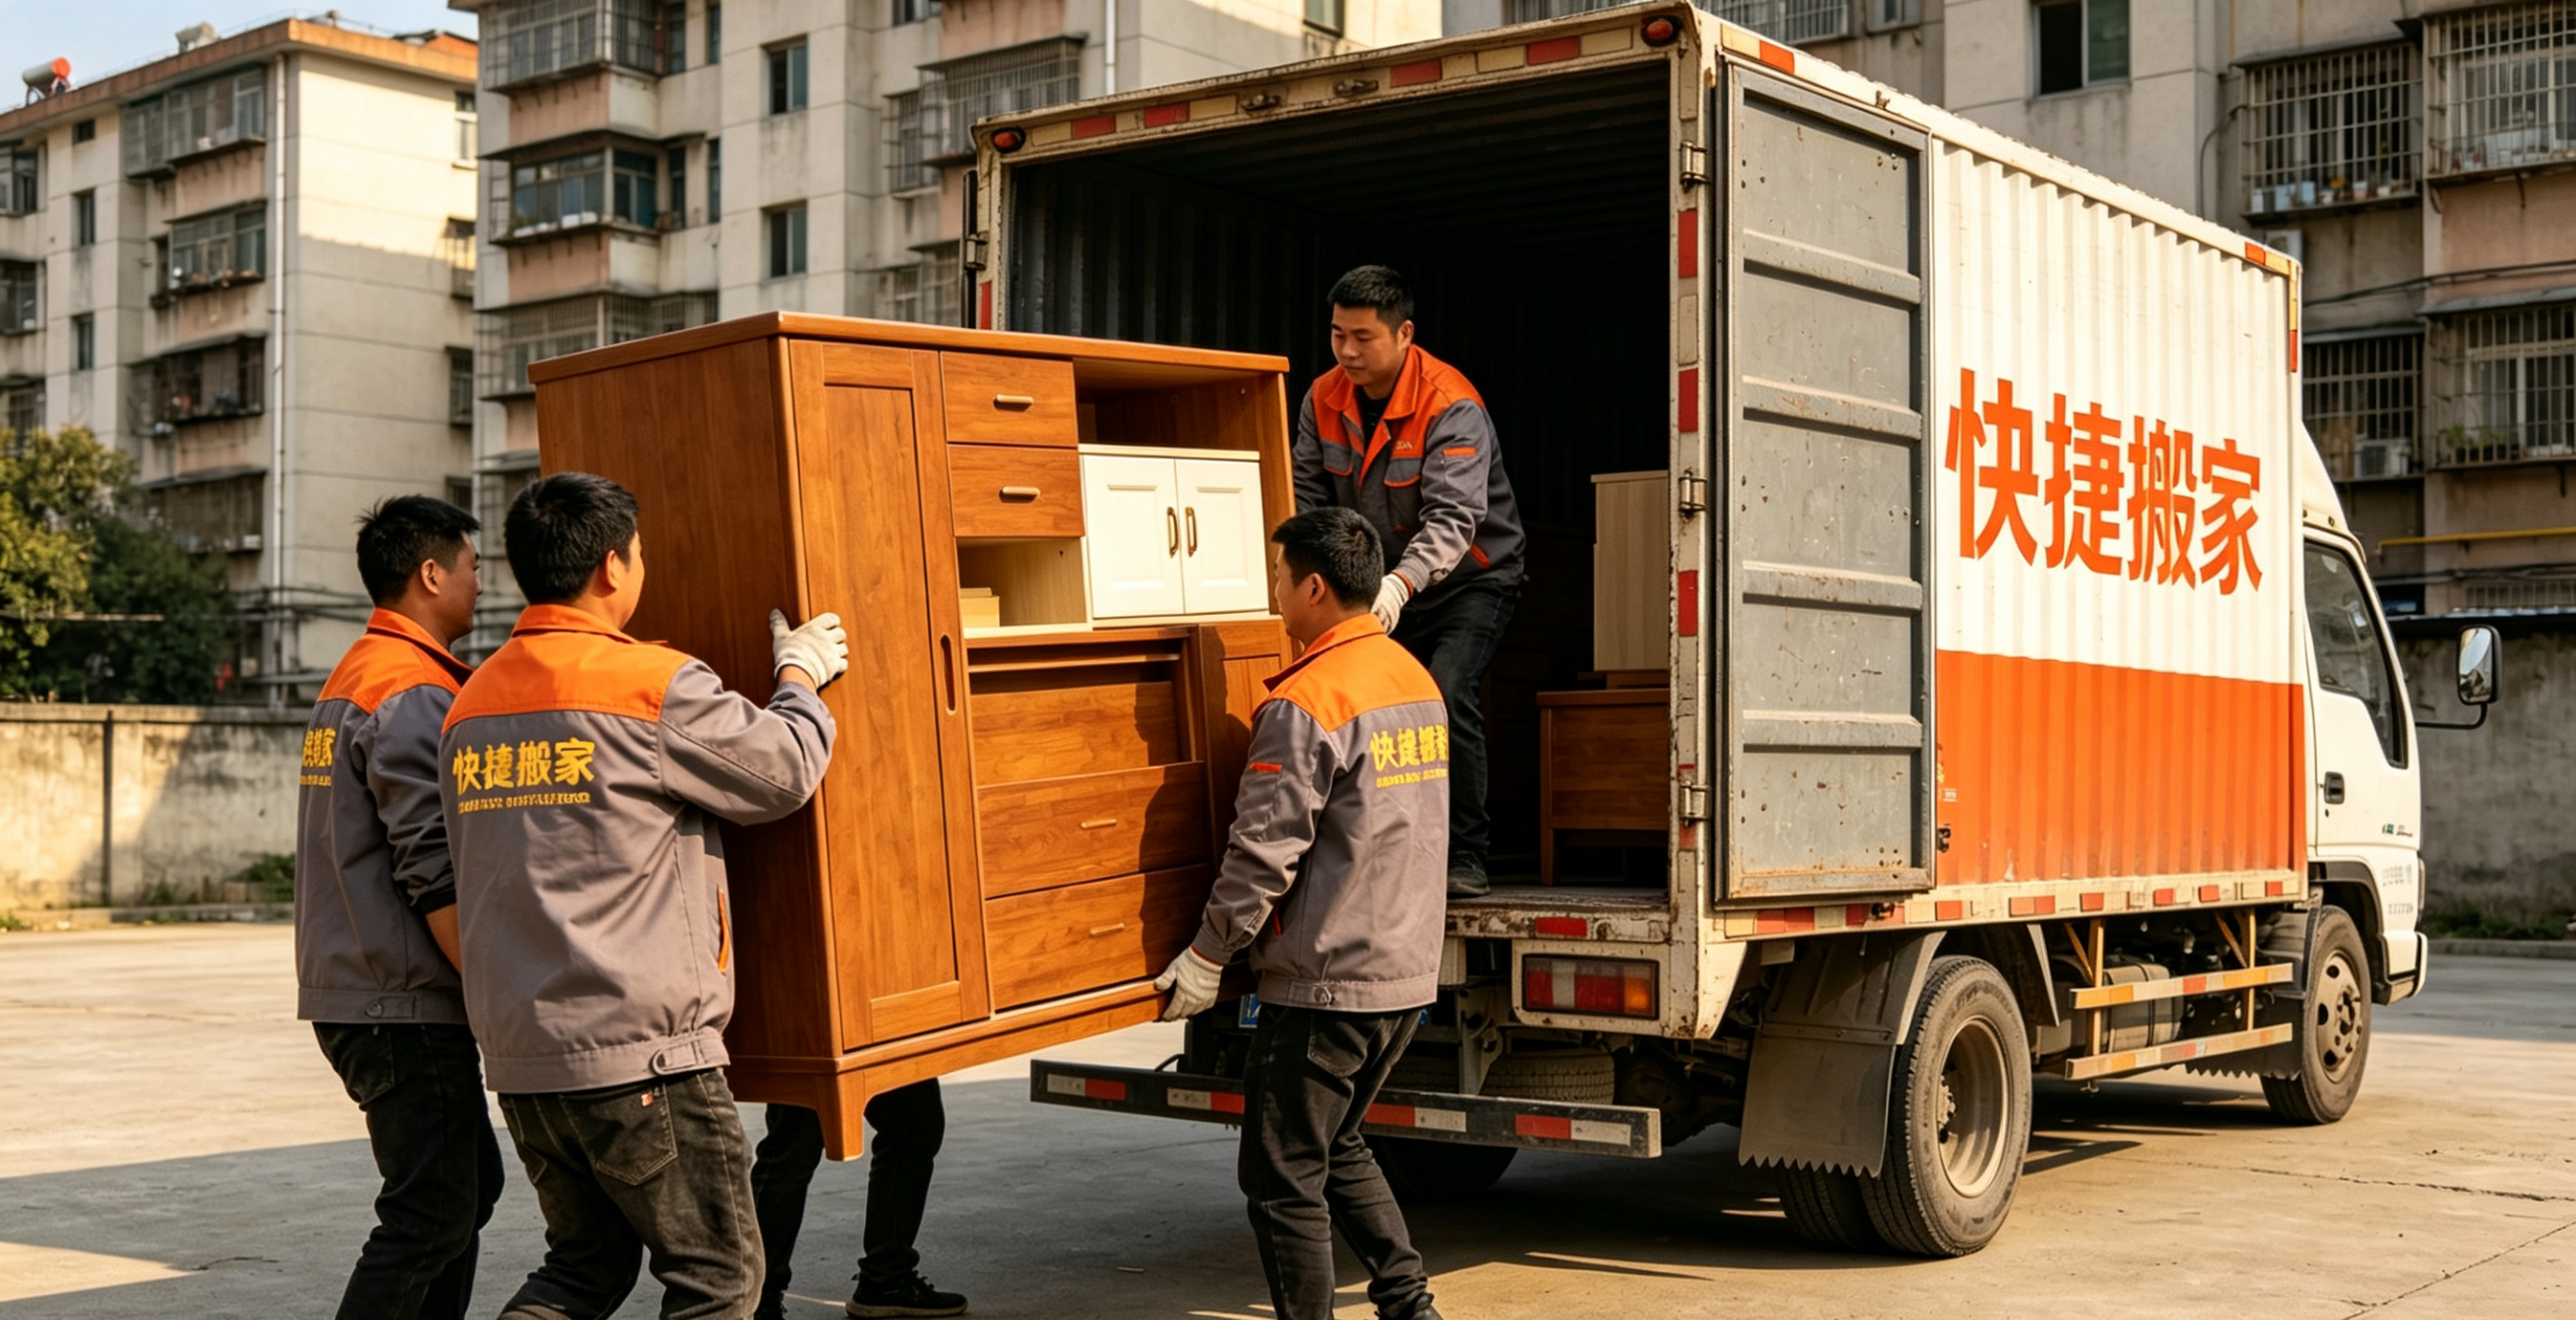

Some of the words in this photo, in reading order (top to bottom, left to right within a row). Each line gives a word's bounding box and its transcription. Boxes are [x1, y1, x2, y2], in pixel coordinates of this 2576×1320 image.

[1945, 367, 2262, 595] 快捷搬家
[453, 736, 595, 796] 快捷搬家
